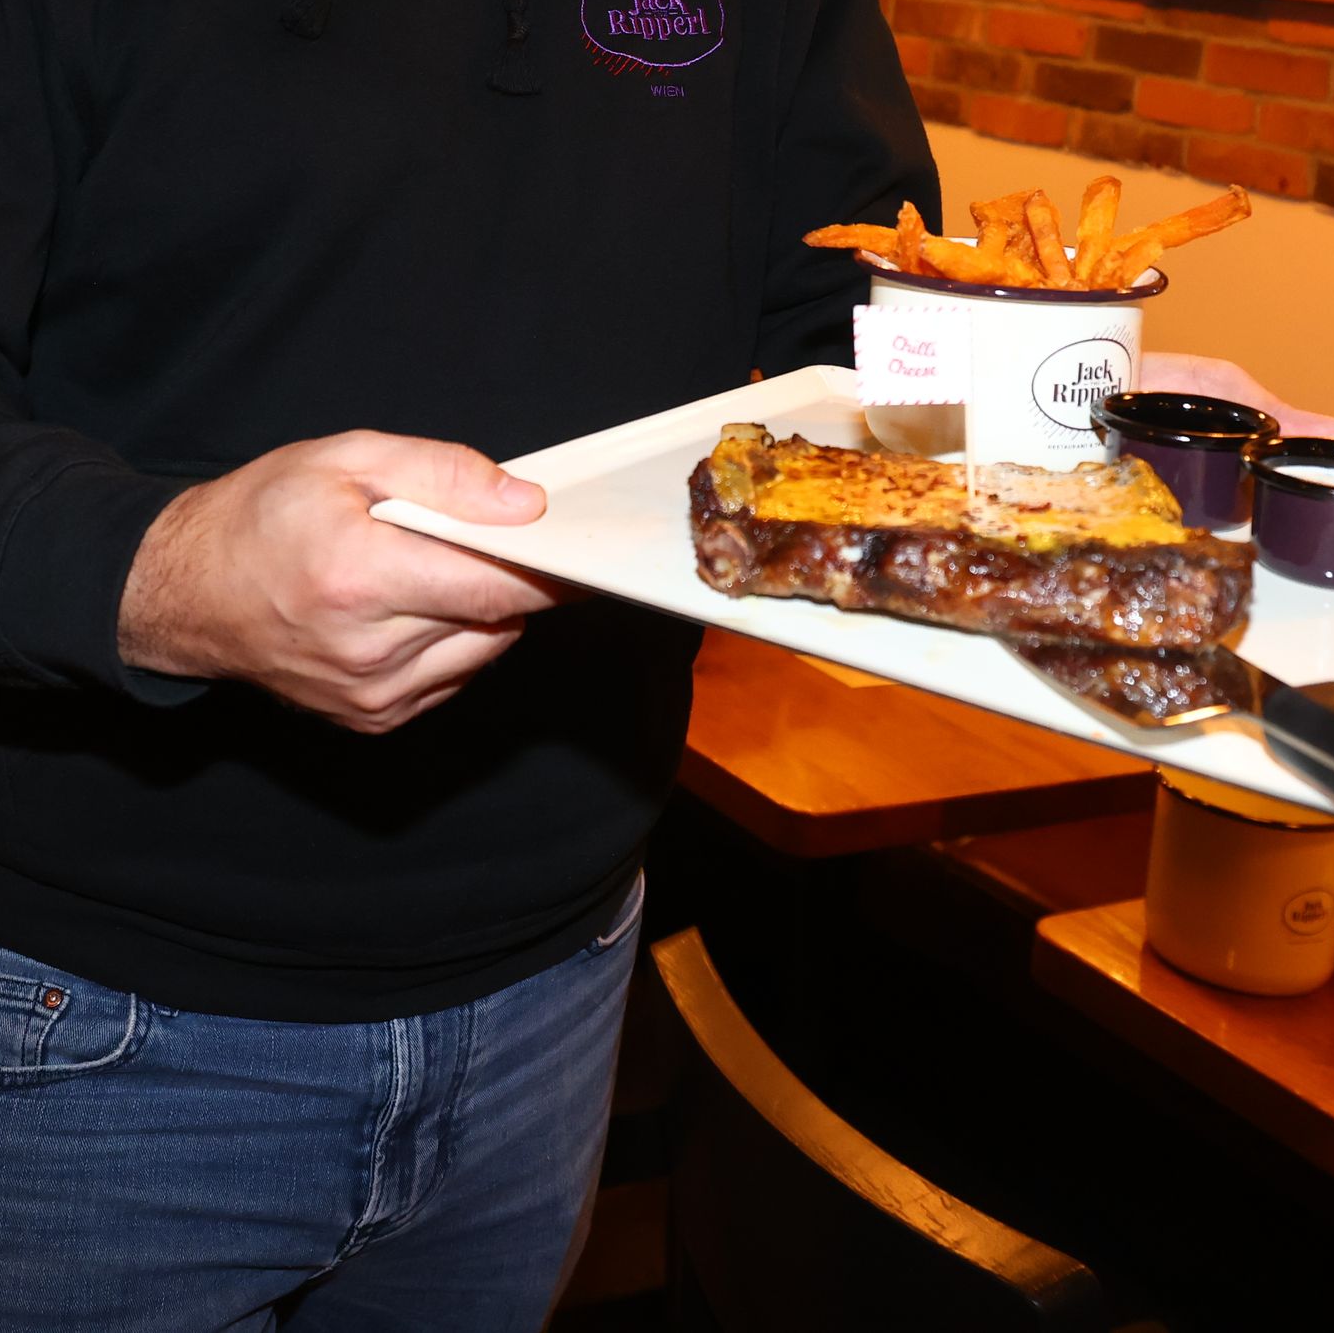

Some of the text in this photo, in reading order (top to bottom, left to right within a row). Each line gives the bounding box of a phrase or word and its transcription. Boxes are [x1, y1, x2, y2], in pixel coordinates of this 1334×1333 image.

[608, 8, 712, 41] Ripperl
[650, 84, 685, 97] WIEN
[1071, 359, 1113, 386] Jack
[1052, 377, 1122, 407] Ripperl
